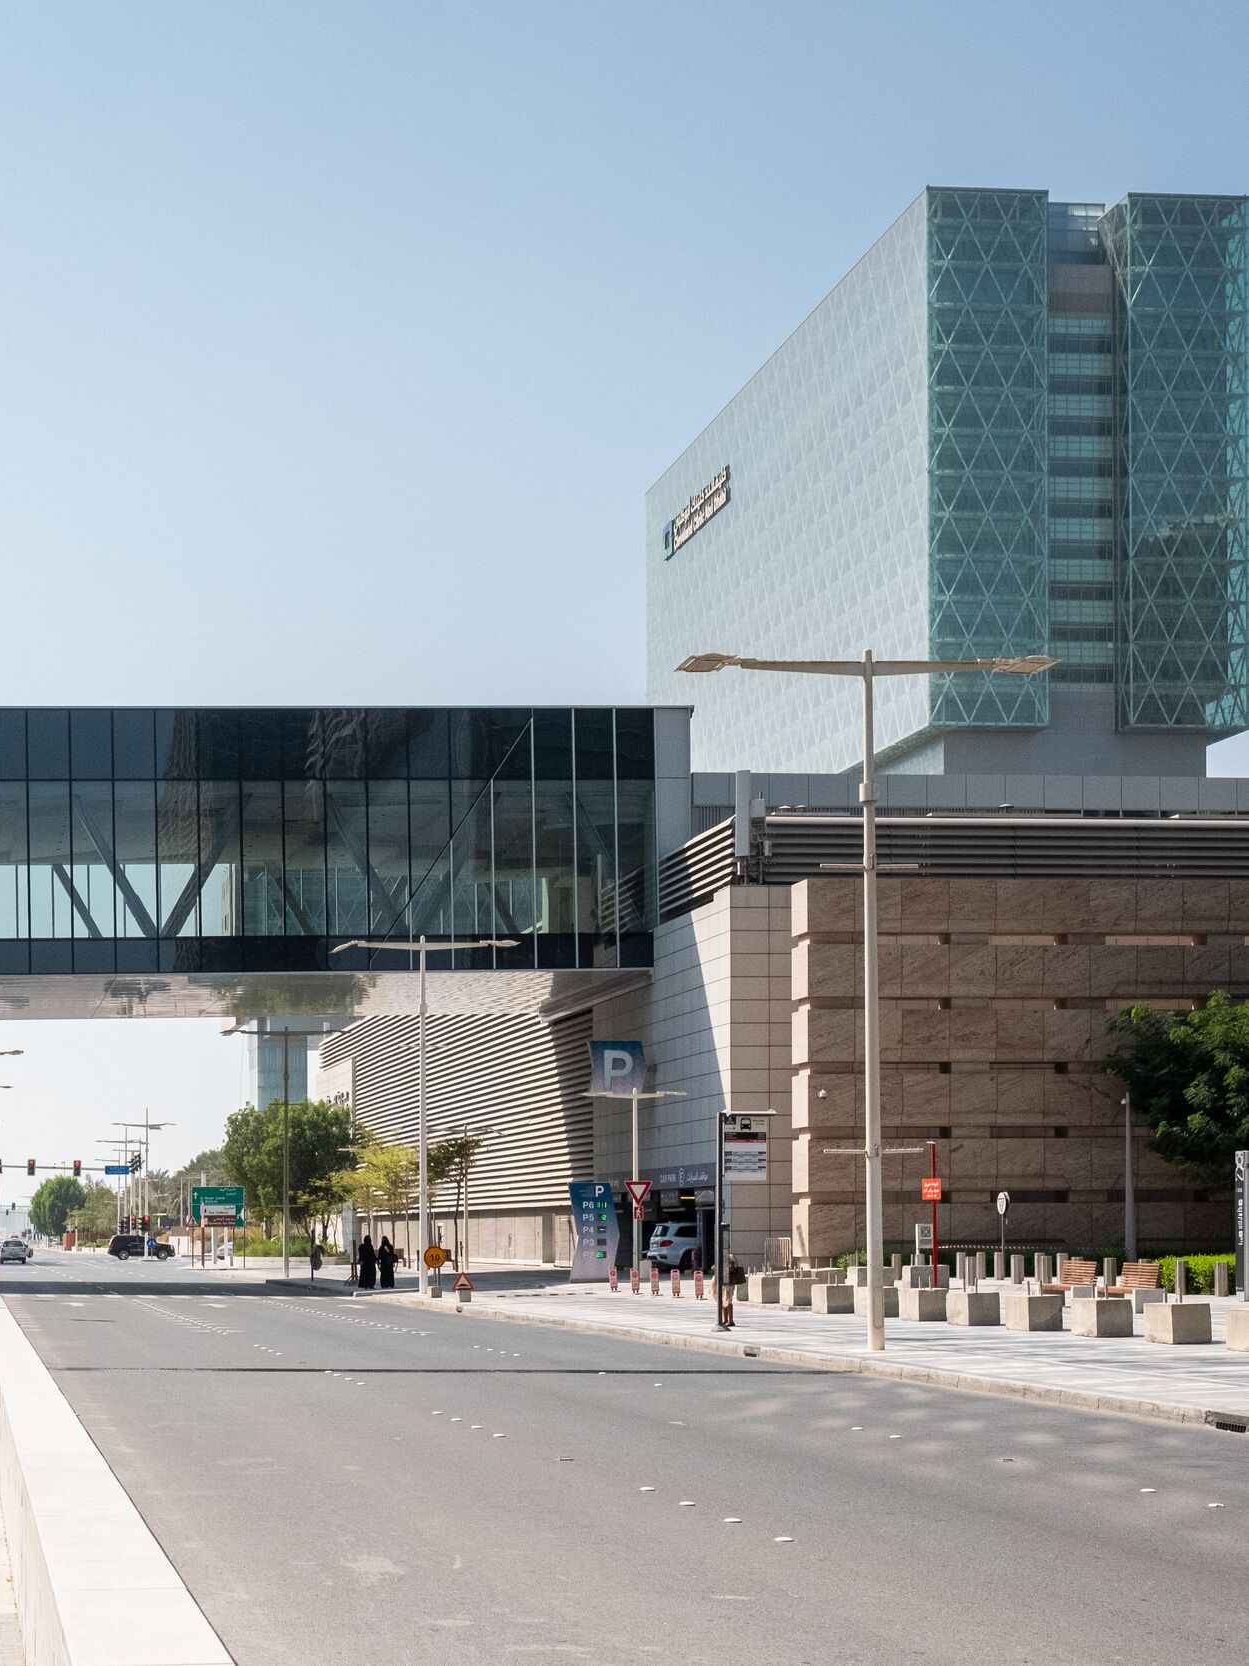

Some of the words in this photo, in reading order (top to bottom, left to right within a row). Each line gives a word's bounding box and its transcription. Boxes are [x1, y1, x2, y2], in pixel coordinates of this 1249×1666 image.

[603, 1049, 633, 1092] P
[660, 1174, 668, 1183] CAR
[668, 1173, 677, 1183] PARK
[595, 1185, 604, 1197] P
[582, 1201, 594, 1209] P6
[582, 1226, 594, 1234] P4
[429, 1253, 440, 1262] 10
[582, 1251, 594, 1259] P2
